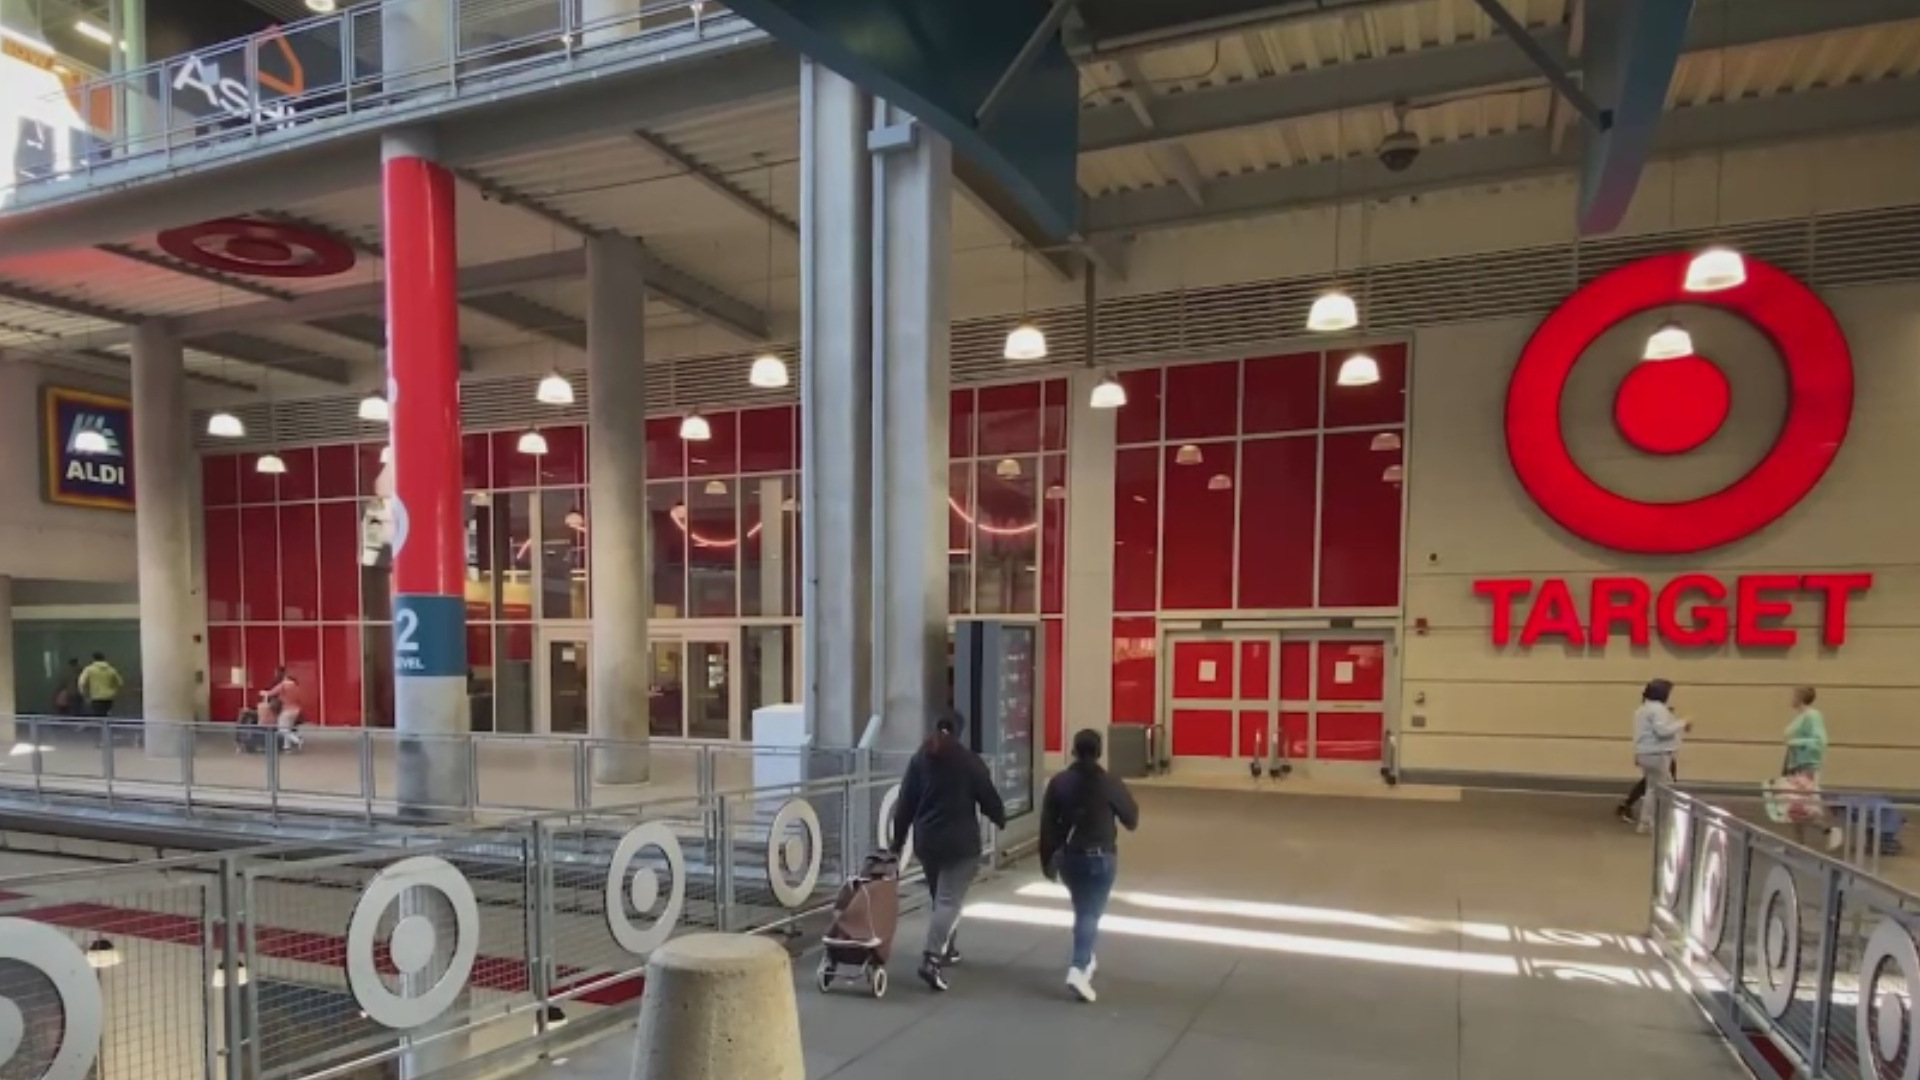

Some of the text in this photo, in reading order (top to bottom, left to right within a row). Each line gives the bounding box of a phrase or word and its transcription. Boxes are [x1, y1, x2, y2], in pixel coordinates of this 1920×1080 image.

[66, 460, 125, 485] ALDI
[396, 608, 419, 651] 2
[1473, 572, 1873, 648] TARGET
